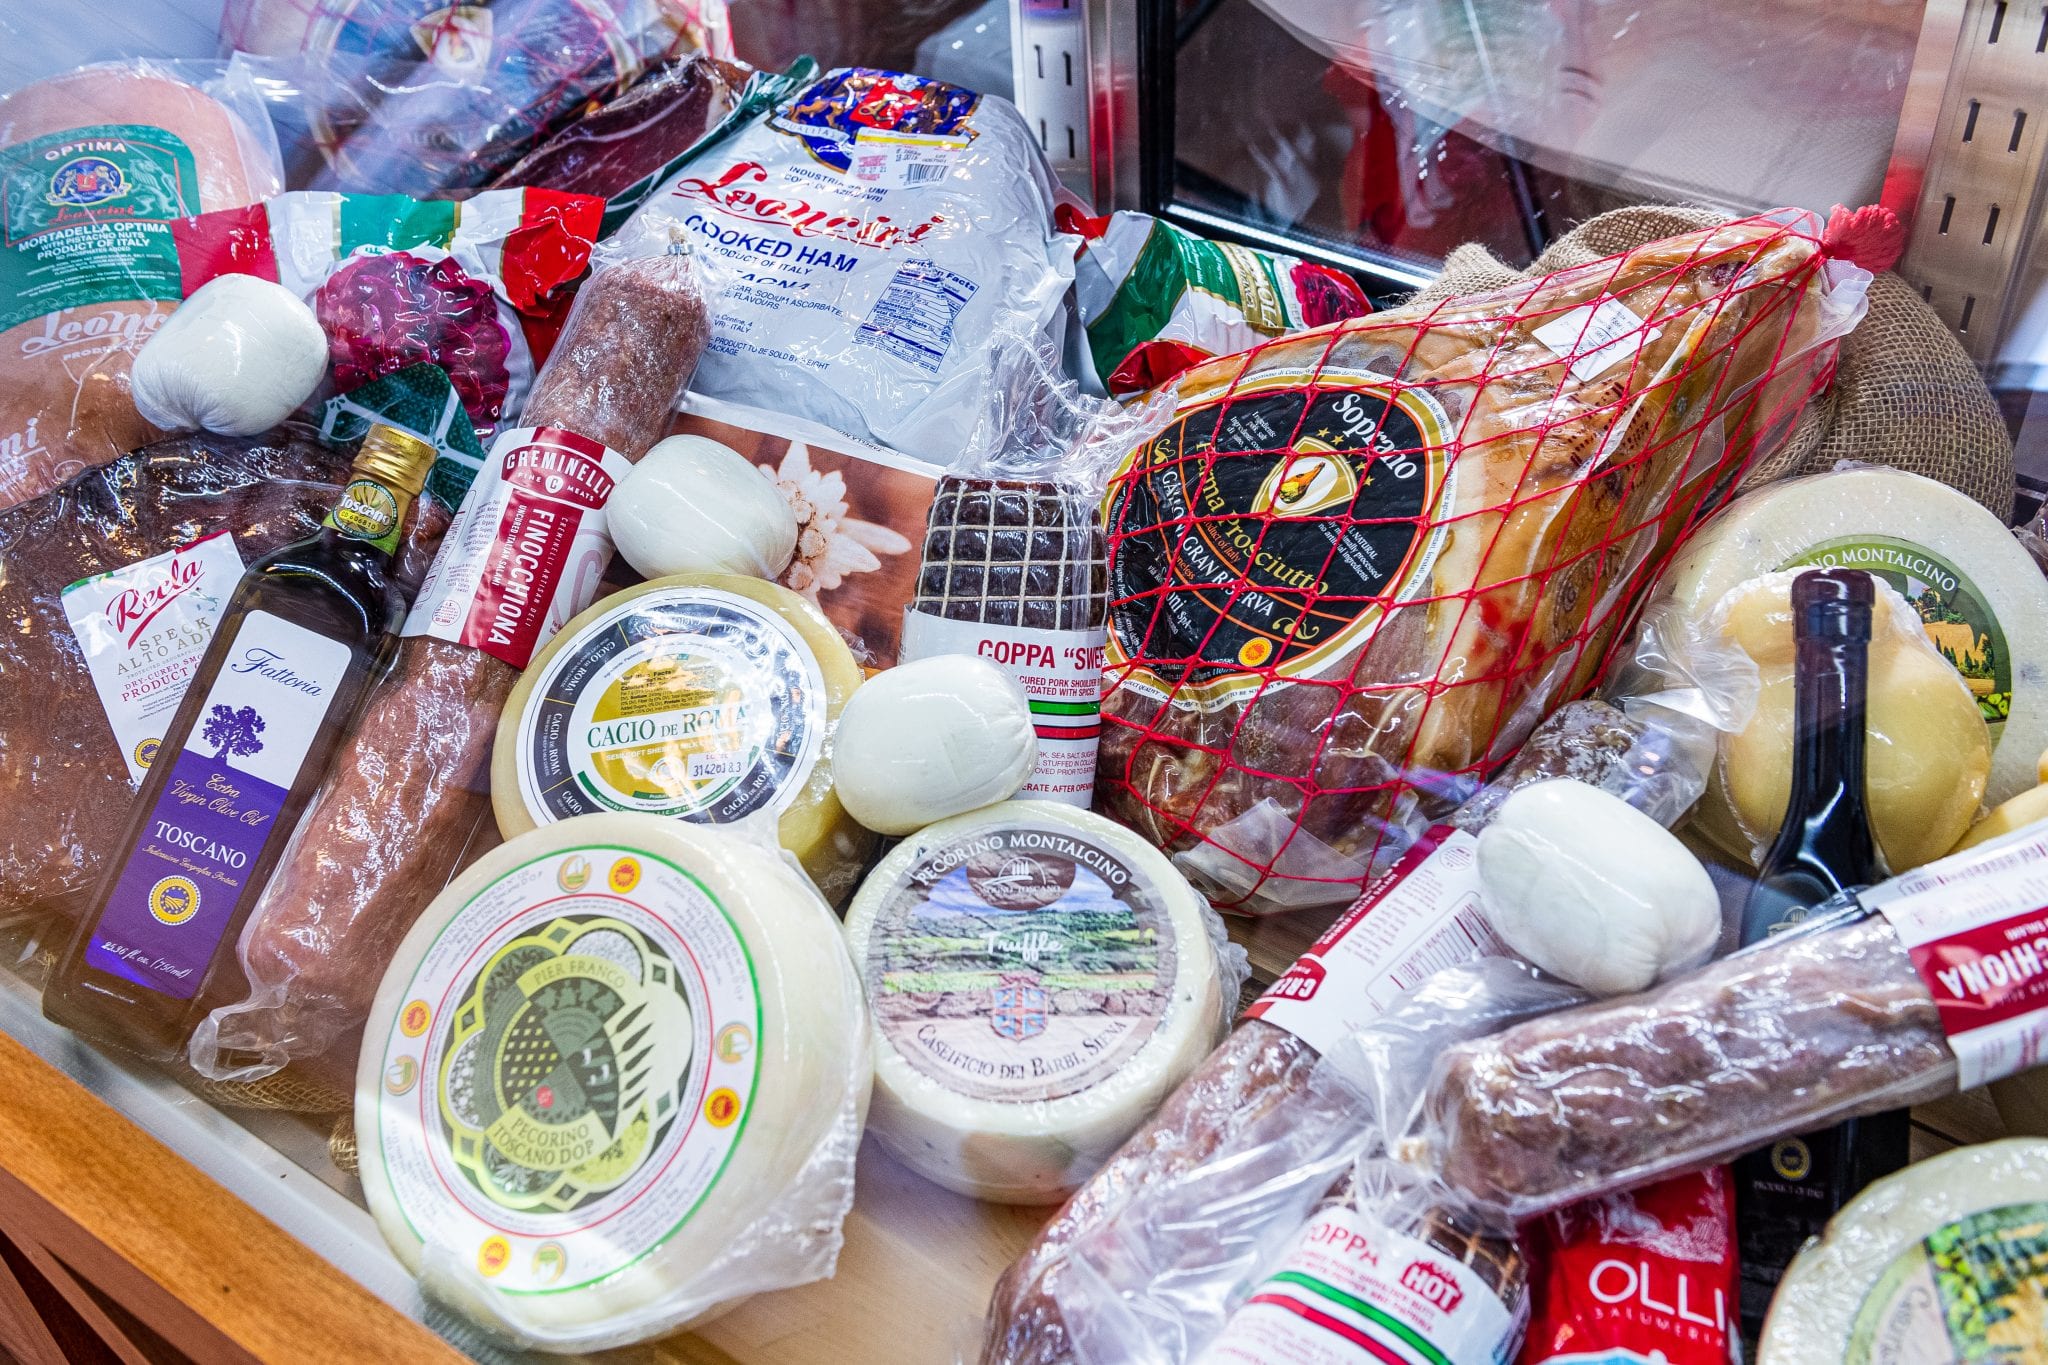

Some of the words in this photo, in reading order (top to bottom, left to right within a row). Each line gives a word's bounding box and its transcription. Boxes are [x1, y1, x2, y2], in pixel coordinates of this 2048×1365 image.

[45, 141, 127, 161] OPTIMA
[676, 161, 945, 248] Leoncini
[18, 223, 111, 252] MORTADELLA
[114, 222, 169, 234] OPTIMA
[37, 240, 93, 261] PRODUCT
[97, 238, 115, 248] OF
[117, 238, 150, 247] ITALY
[40, 240, 65, 251] WITH
[66, 232, 117, 245] PISTACHIO
[118, 231, 145, 240] NUTS
[684, 215, 793, 258] COOKED
[798, 246, 858, 273] HAM
[760, 258, 776, 268] OF
[778, 263, 813, 276] ITALY
[946, 272, 976, 292] Facts
[733, 290, 780, 310] FLAVOURS
[754, 289, 790, 305] SODIUM
[730, 323, 751, 334] ITALY
[707, 343, 739, 357] PACKAGE
[714, 336, 748, 350] PRODUCT
[758, 348, 768, 356] BE
[769, 350, 789, 360] SOLD
[1332, 393, 1418, 479] Soprano
[506, 449, 610, 500] CREMINELLI
[518, 471, 542, 484] FINE
[567, 485, 595, 502] MEATS
[339, 493, 391, 526] Toscano
[509, 505, 528, 535] UNCURED
[501, 535, 516, 560] ITALIAN
[546, 516, 569, 566] CREMINELLI
[1218, 509, 1329, 596] Prosciutto
[1352, 532, 1378, 560] NATURAL
[1176, 555, 1196, 581] neless
[1182, 536, 1216, 577] GRAN
[1342, 551, 1370, 582] ingredients
[1353, 552, 1383, 579] processed
[1842, 547, 1956, 592] MONTALCINO
[487, 508, 555, 646] FINOCCHIONA
[491, 561, 507, 586] SALAMI
[534, 568, 551, 604] ARTISAN
[525, 608, 538, 627] DELI
[138, 617, 211, 651] SPECK
[117, 645, 168, 676] ALTO
[177, 628, 213, 650] ADI
[590, 640, 616, 664] CACIO
[978, 639, 1056, 669] COPPA
[1063, 645, 1106, 671] “SWEE
[121, 667, 189, 702] PRODUCT
[124, 662, 180, 690] DRY-CURED
[231, 647, 323, 698] Fattoria
[564, 667, 587, 692] ROMA
[1019, 675, 1046, 687] CURED
[1048, 678, 1069, 688] PORK
[1025, 685, 1056, 696] COATED
[1059, 687, 1077, 697] WITH
[1078, 688, 1095, 697] SPICES
[549, 713, 563, 741] CACIO
[587, 718, 656, 749] CACIO
[660, 723, 679, 738] DE
[549, 747, 562, 776] ROMA
[1043, 760, 1073, 768] STUFFED
[1051, 752, 1065, 760] SEA
[1034, 767, 1056, 775] OVED
[1057, 767, 1076, 775] PRIOR
[205, 773, 241, 799] Extra
[1052, 783, 1074, 793] AFTER
[169, 779, 207, 807] Virgin
[208, 797, 240, 819] Olive
[240, 809, 270, 827] Oil
[562, 789, 582, 813] CACIO
[721, 794, 751, 817] CACIO
[155, 820, 248, 870] TOSCANO
[914, 834, 1004, 887] PECORINO
[1009, 832, 1128, 886] MONTALCINO
[979, 930, 1064, 962] Truffle
[534, 963, 564, 985] PIER
[568, 960, 626, 989] FRANCO
[494, 1123, 556, 1166] TOSCANO
[559, 1139, 595, 1166] DOP
[511, 1117, 589, 1148] PECORINO
[1311, 1222, 1379, 1268] OPPA
[1402, 1261, 1459, 1313] HOT
[1588, 1258, 1726, 1332] OLLI
[1594, 1306, 1725, 1348] SALUMERIA
